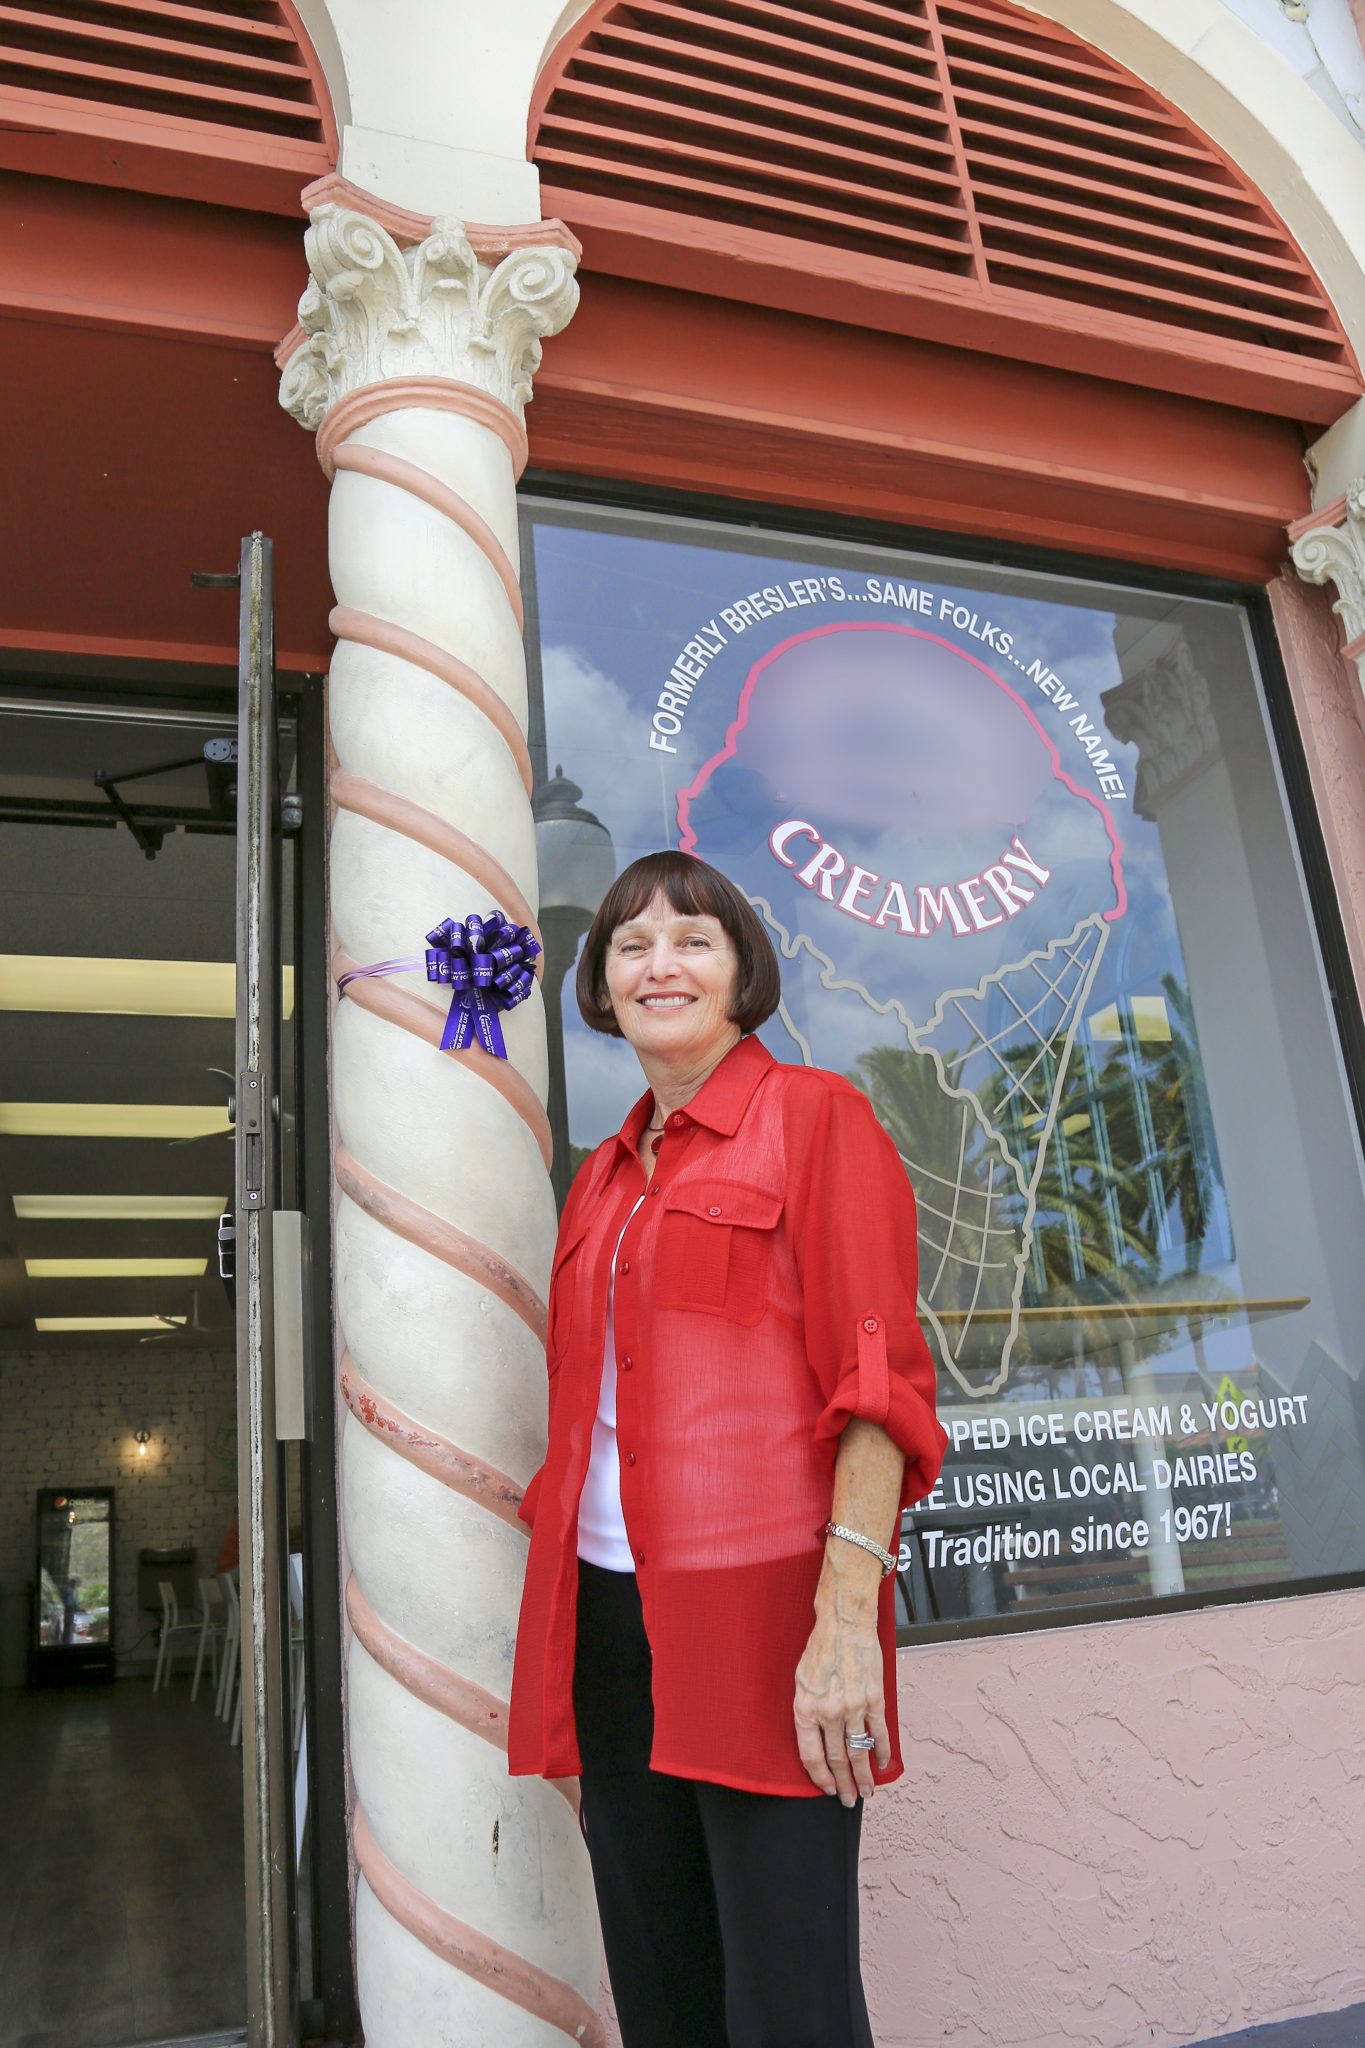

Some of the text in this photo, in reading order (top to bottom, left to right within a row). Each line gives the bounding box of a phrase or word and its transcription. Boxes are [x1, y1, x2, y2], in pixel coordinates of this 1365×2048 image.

[648, 619, 729, 754] FORMERLY
[1068, 713, 1127, 801] NAME!
[769, 819, 1052, 938] CREAMERY
[1019, 1413, 1067, 1447] ICE
[1073, 1405, 1172, 1443] CREAM
[1179, 1404, 1198, 1434] &
[1201, 1395, 1309, 1433] YOGURT
[954, 1470, 1046, 1509] USING
[1053, 1461, 1147, 1499] LOCAL
[1152, 1451, 1257, 1490] DAIRIES
[922, 1523, 1060, 1569] Tradition
[1070, 1516, 1149, 1554] since
[1159, 1502, 1232, 1544] 1967!
